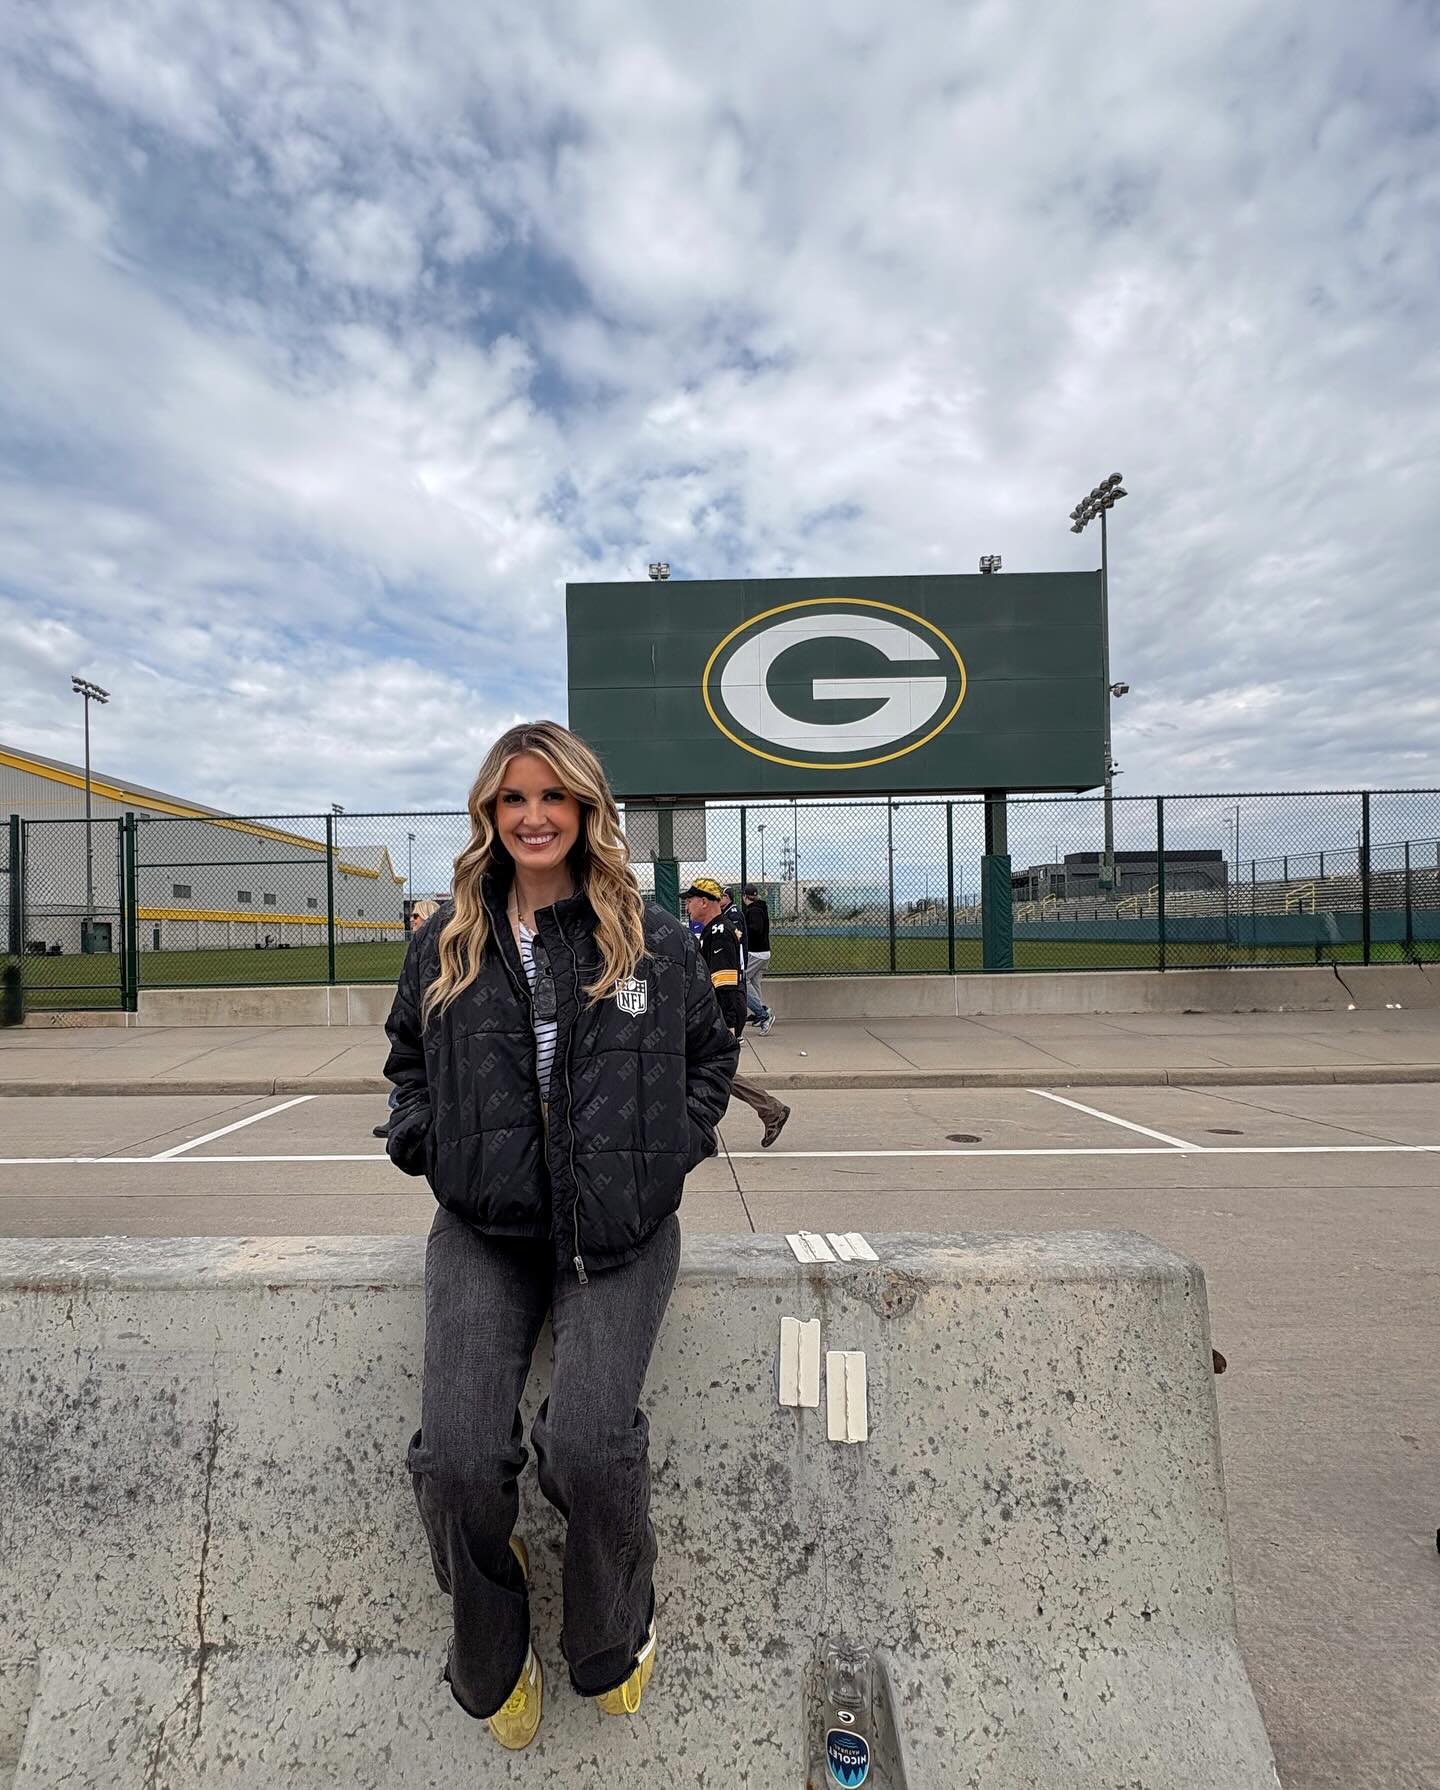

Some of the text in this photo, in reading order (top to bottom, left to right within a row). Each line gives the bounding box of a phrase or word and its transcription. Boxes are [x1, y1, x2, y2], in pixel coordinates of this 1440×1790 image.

[720, 614, 947, 753] G
[711, 923, 725, 935] 54
[621, 992, 645, 1010] NFL
[583, 1095, 608, 1120] NFL
[837, 1711, 855, 1724] G
